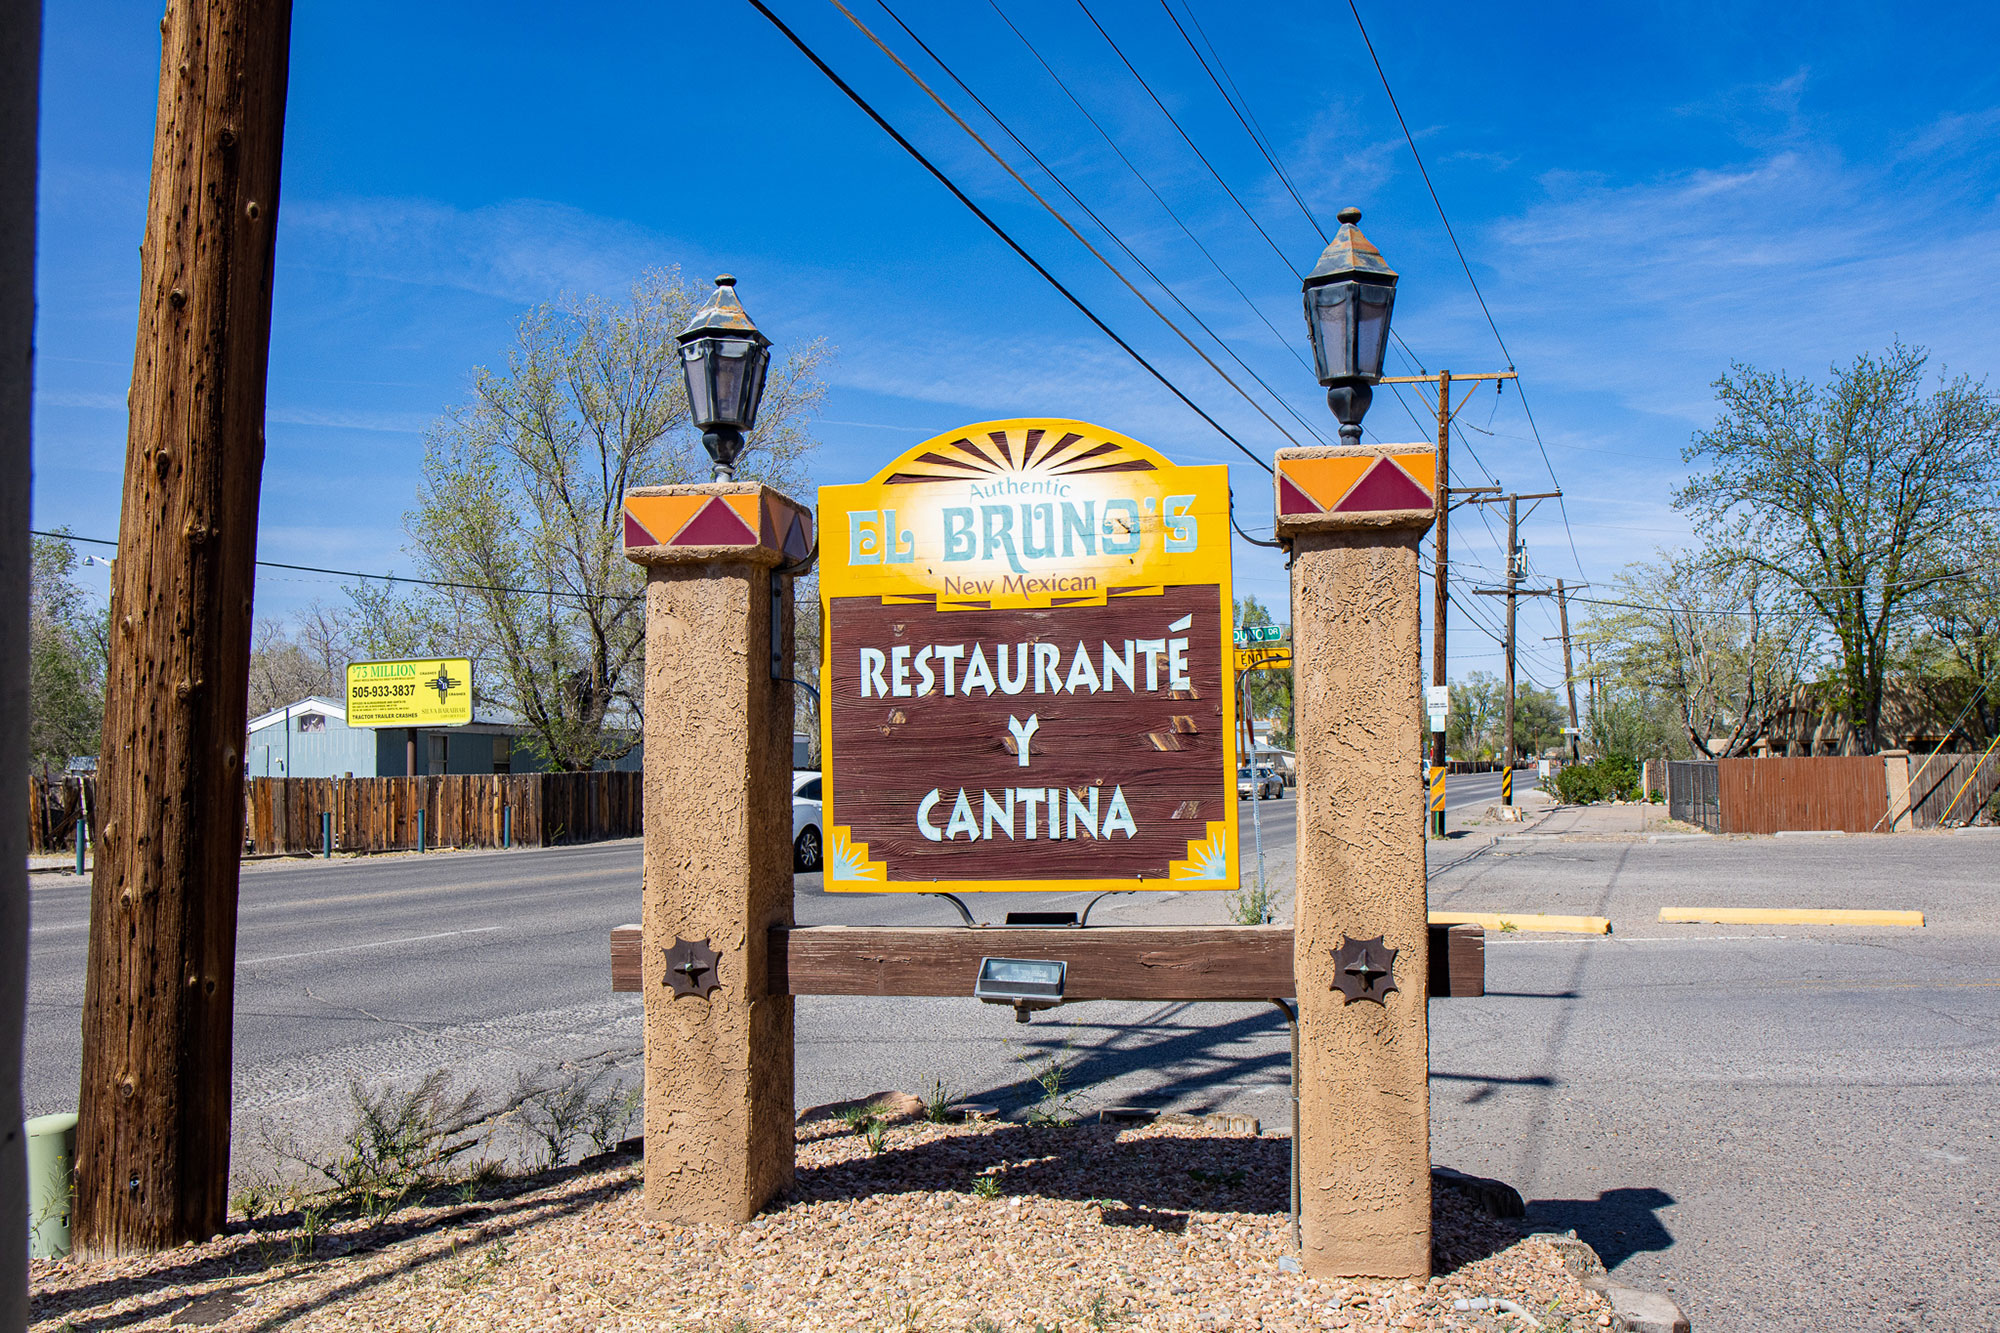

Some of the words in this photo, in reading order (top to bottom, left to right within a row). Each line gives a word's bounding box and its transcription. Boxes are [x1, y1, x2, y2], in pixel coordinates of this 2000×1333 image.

[969, 476, 1071, 503] Authentic
[846, 509, 915, 566] EL
[941, 494, 1198, 574] BRUNO'S
[944, 576, 995, 595] New
[1002, 573, 1097, 601] Mexican
[371, 664, 416, 678] MILLION
[860, 613, 1193, 699] RESTAURANTÉ
[352, 685, 416, 698] 505-933-3837
[1008, 713, 1039, 767] Y
[917, 784, 1138, 842] CANTINA
